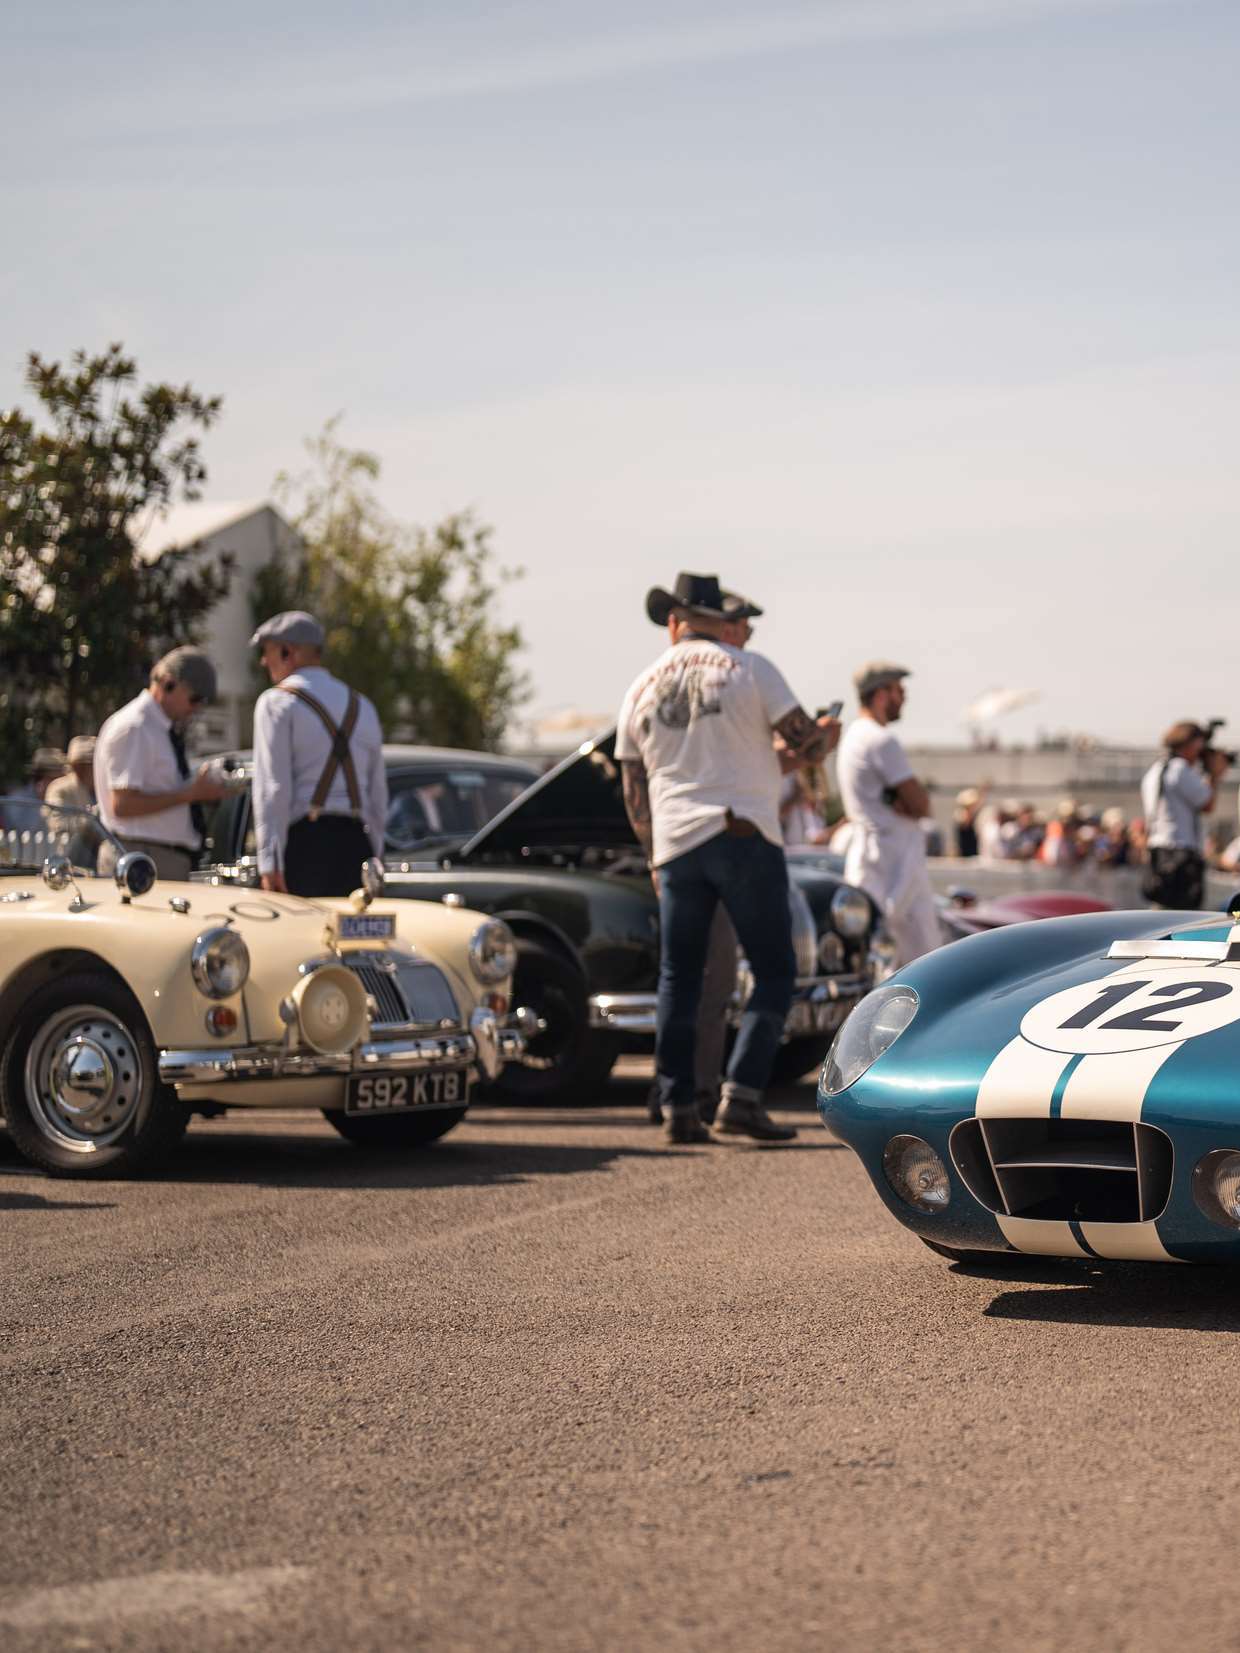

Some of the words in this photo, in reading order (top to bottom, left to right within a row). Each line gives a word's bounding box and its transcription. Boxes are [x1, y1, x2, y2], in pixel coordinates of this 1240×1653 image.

[1056, 980, 1233, 1032] 12
[357, 1077, 407, 1108] 592
[414, 1071, 459, 1104] KTB
